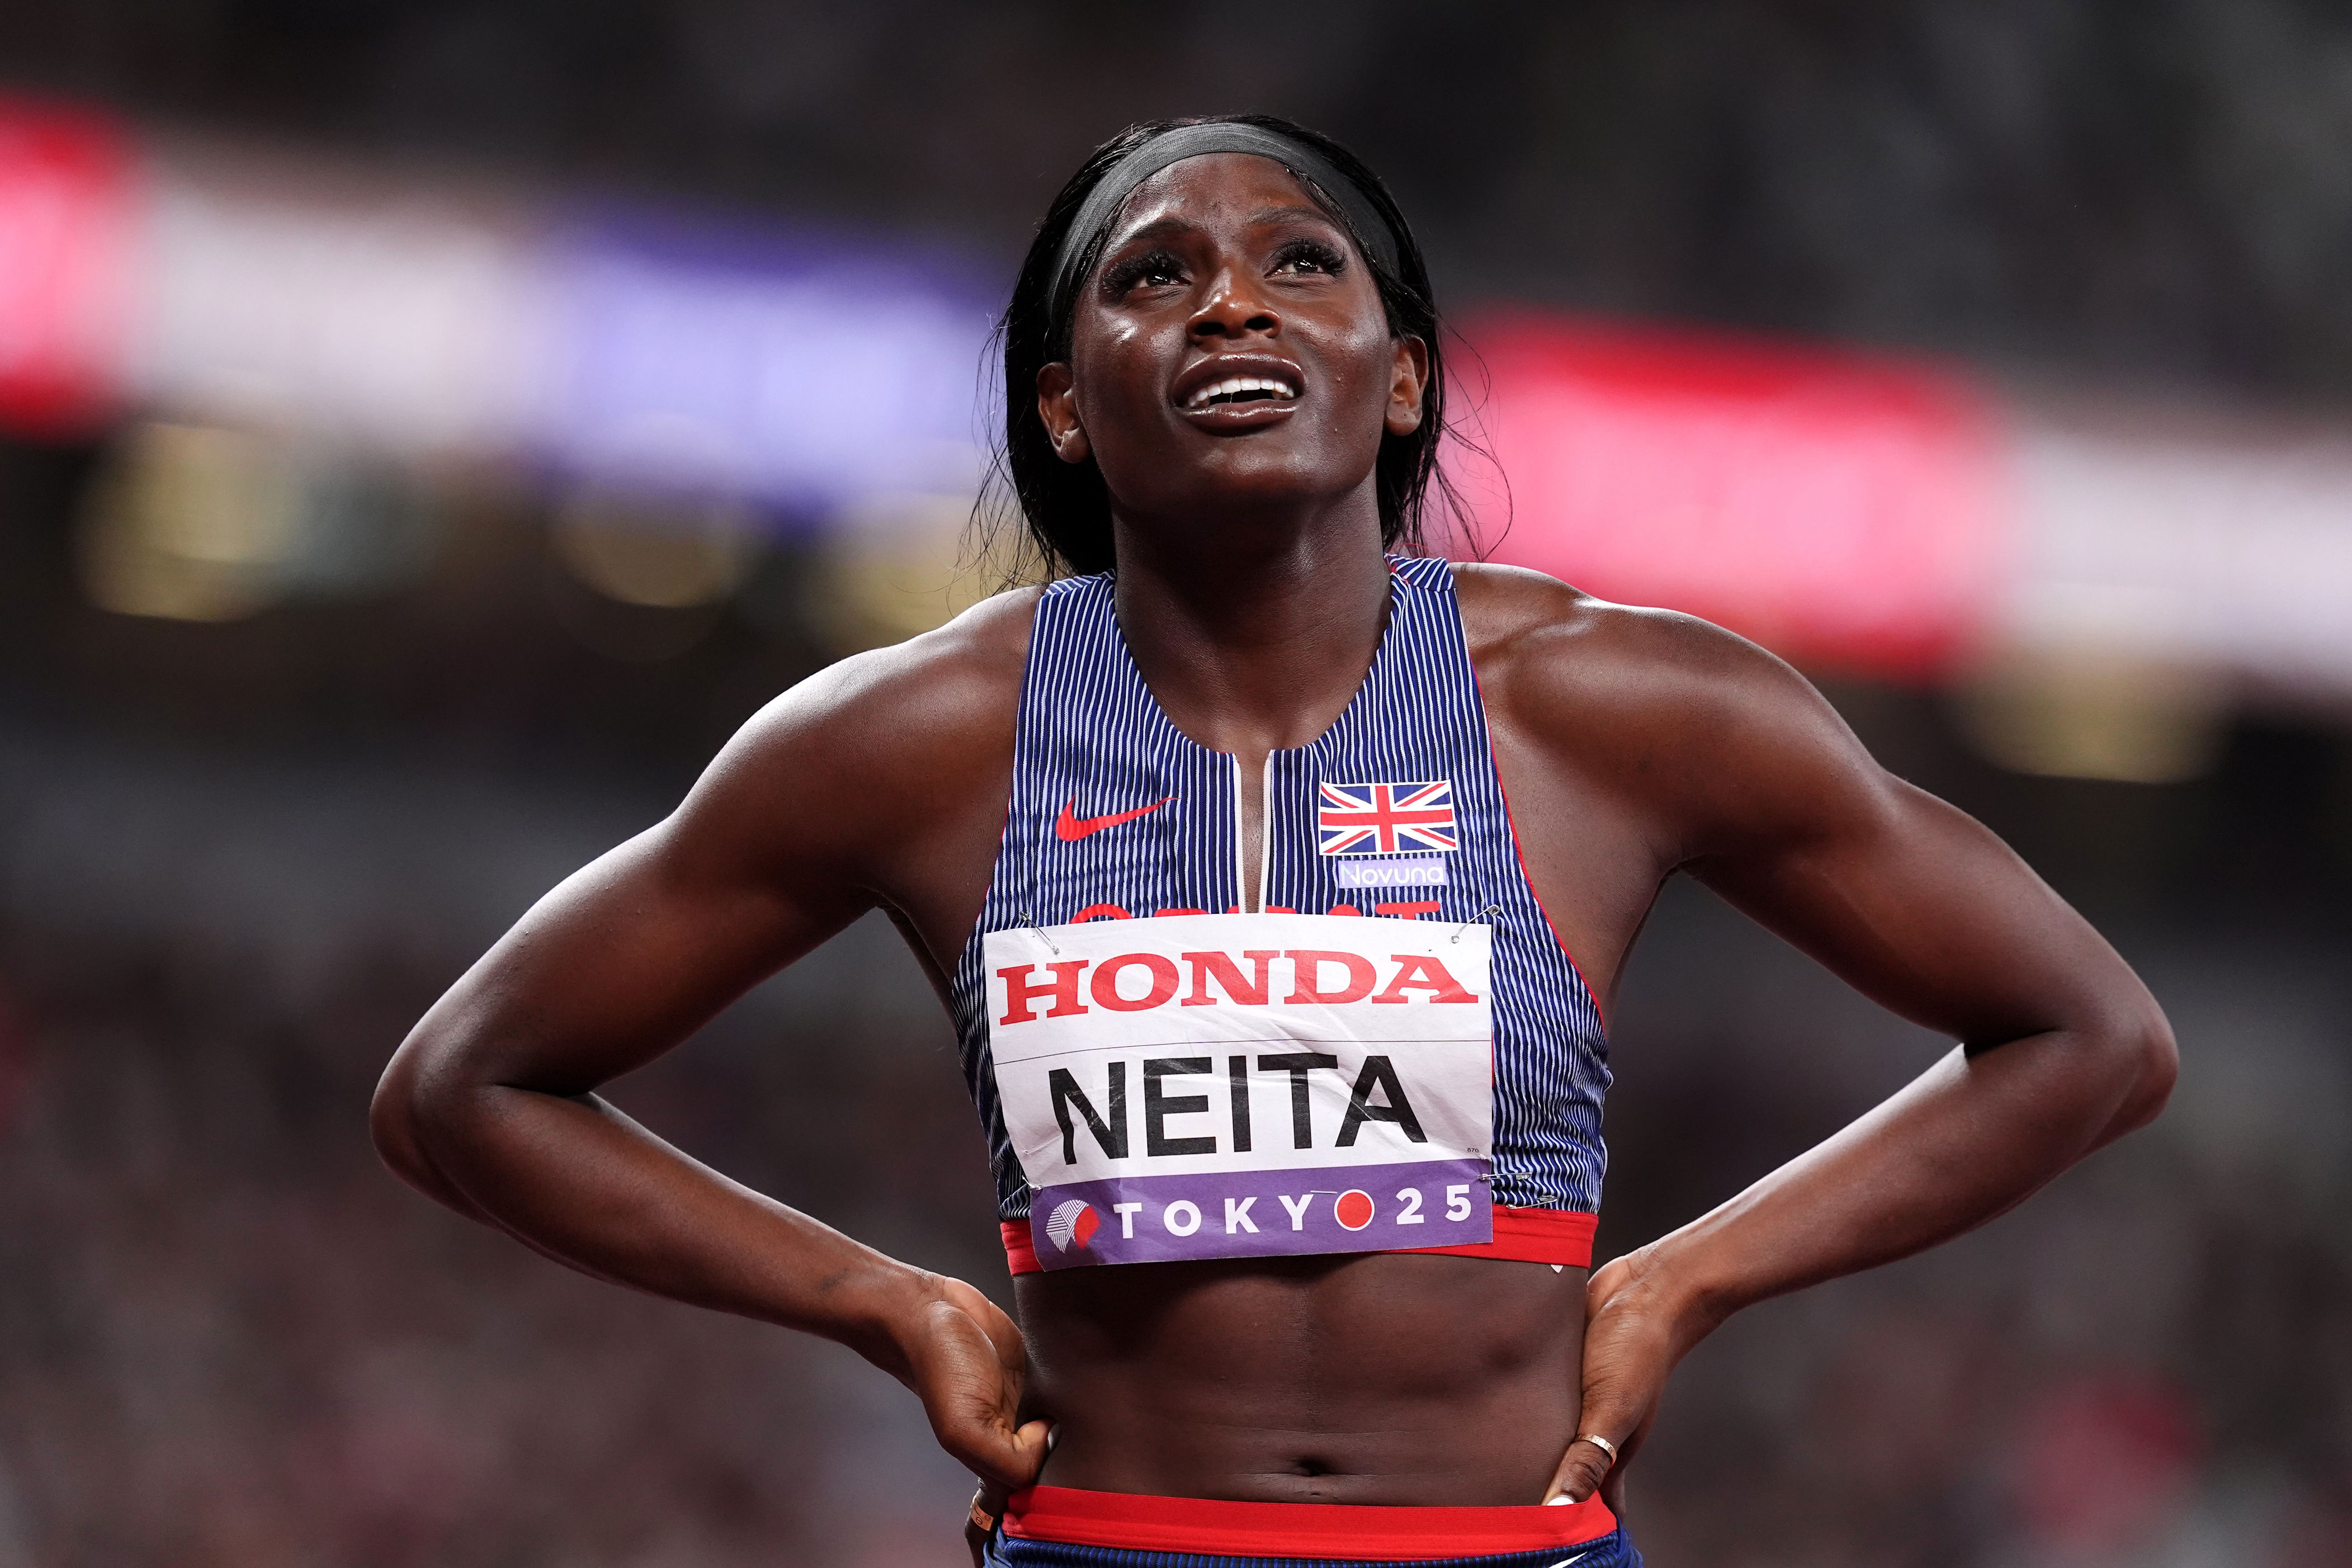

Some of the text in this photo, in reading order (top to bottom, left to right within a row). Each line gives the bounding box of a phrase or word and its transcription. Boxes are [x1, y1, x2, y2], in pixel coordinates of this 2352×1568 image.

[1341, 864, 1444, 885] Novuna
[996, 950, 1479, 1026] HONDA
[1049, 1052, 1428, 1165] NEITA
[1113, 1184, 1472, 1239] TOKYO 25
